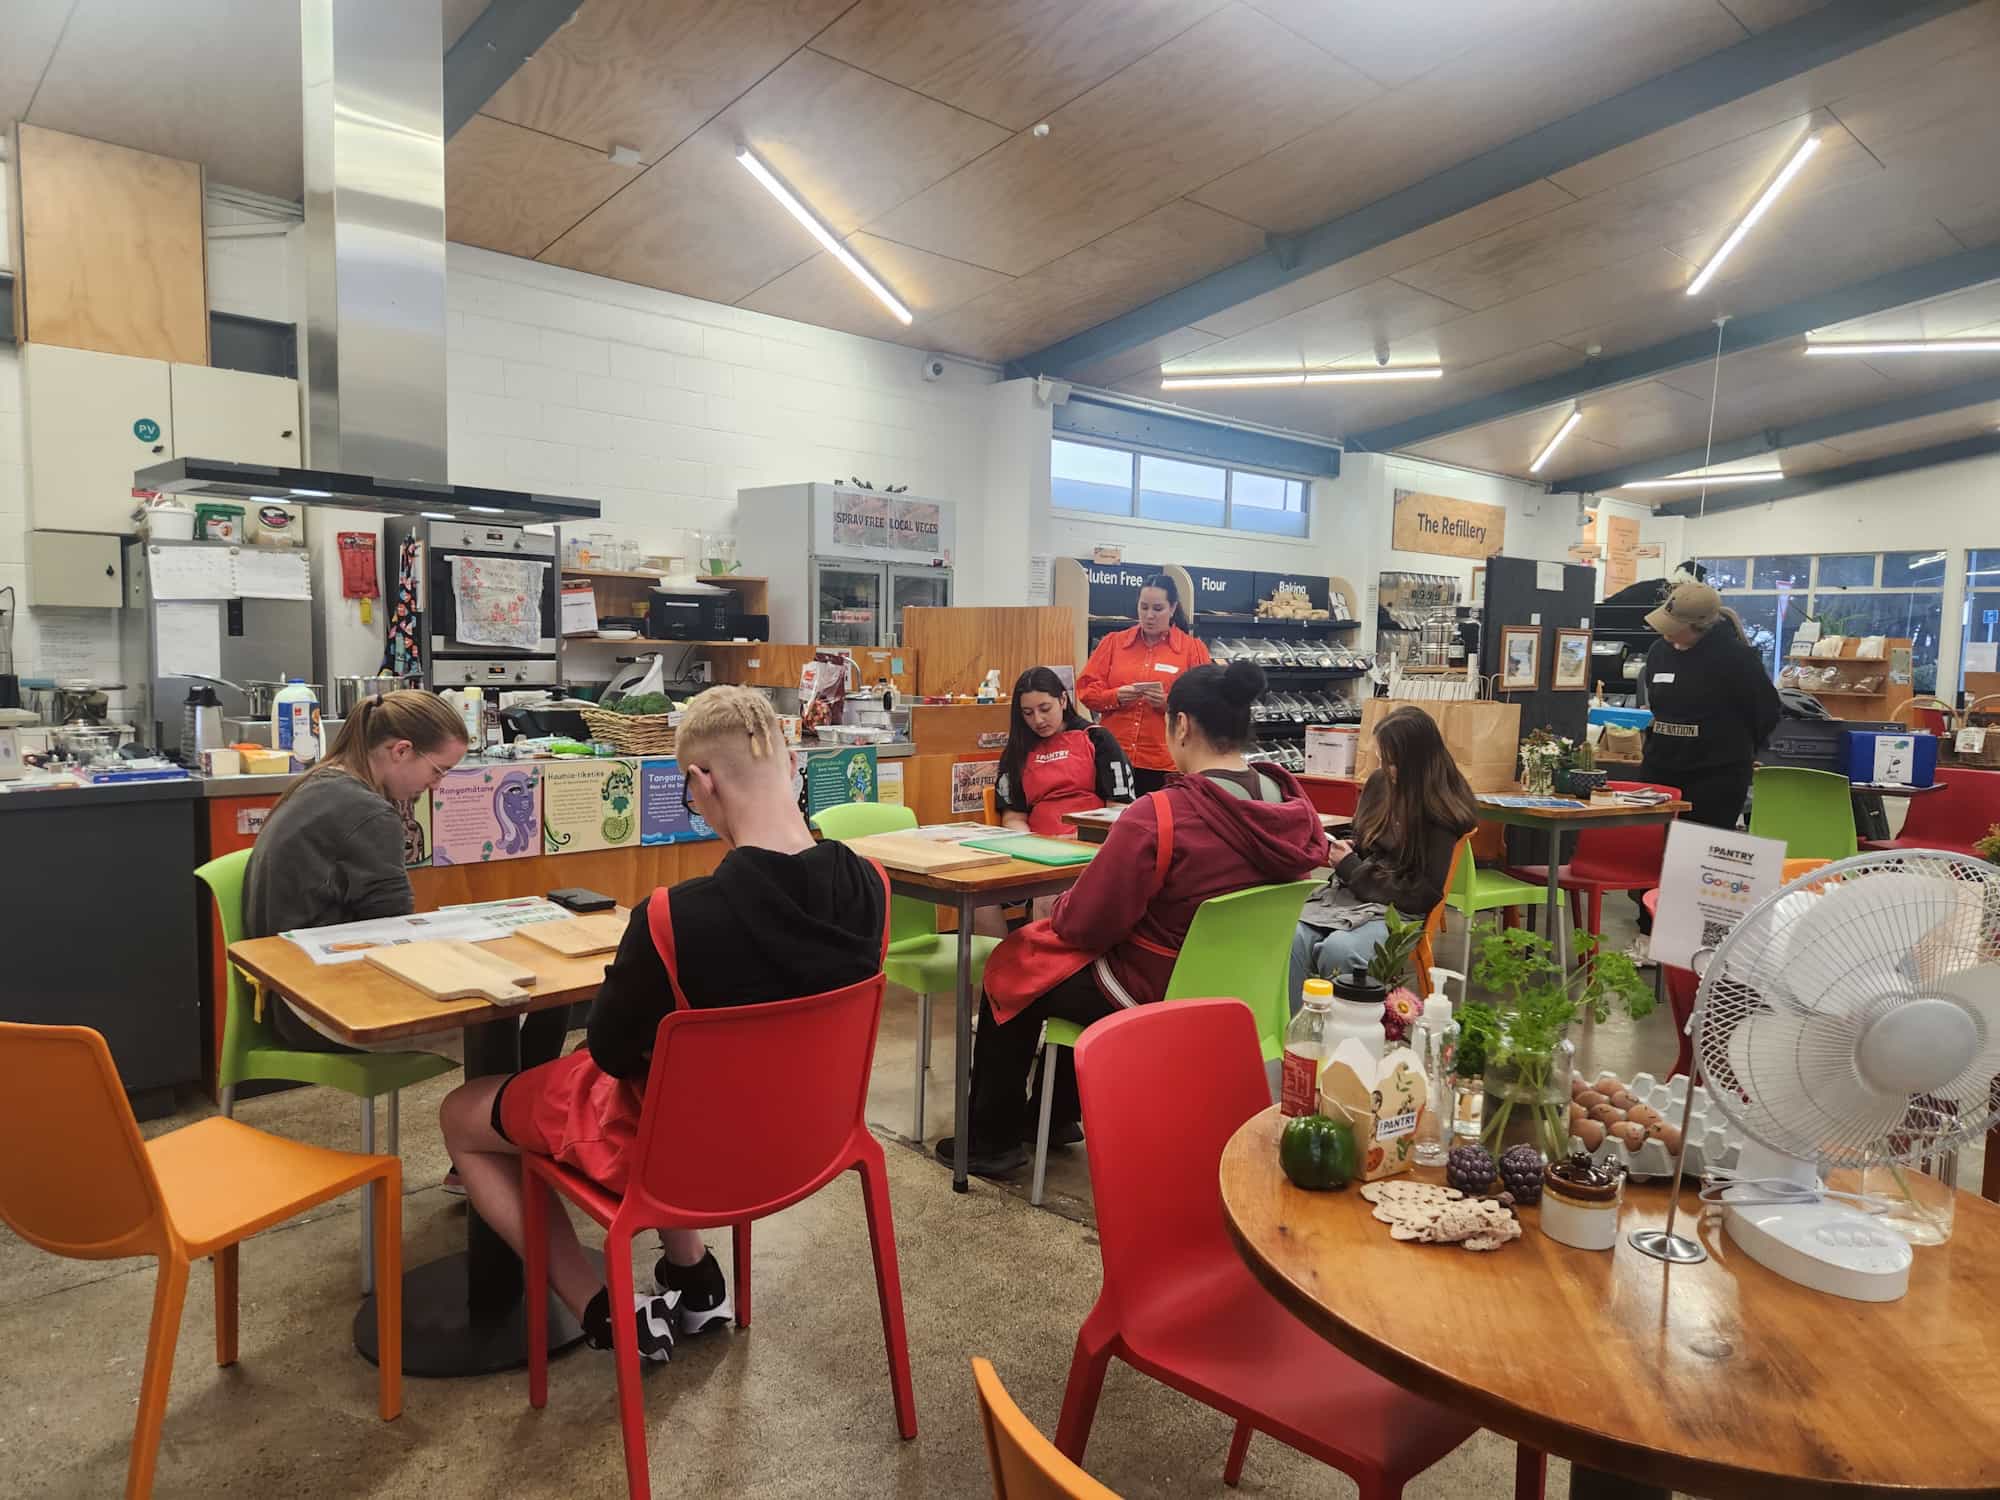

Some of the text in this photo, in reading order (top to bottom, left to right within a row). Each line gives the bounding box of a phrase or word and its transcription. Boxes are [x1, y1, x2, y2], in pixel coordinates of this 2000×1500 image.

[139, 424, 156, 435] PV
[836, 511, 885, 528] SPRAY FREE
[889, 517, 938, 535] LOCAL VEGES
[1417, 512, 1487, 545] The Refillery
[1083, 567, 1143, 587] luten Free
[1201, 576, 1227, 592] Flour
[1279, 580, 1307, 595] Baking
[1714, 846, 1755, 861] PANTRY
[1702, 872, 1751, 893] Google
[1383, 1115, 1415, 1130] PANTRY
